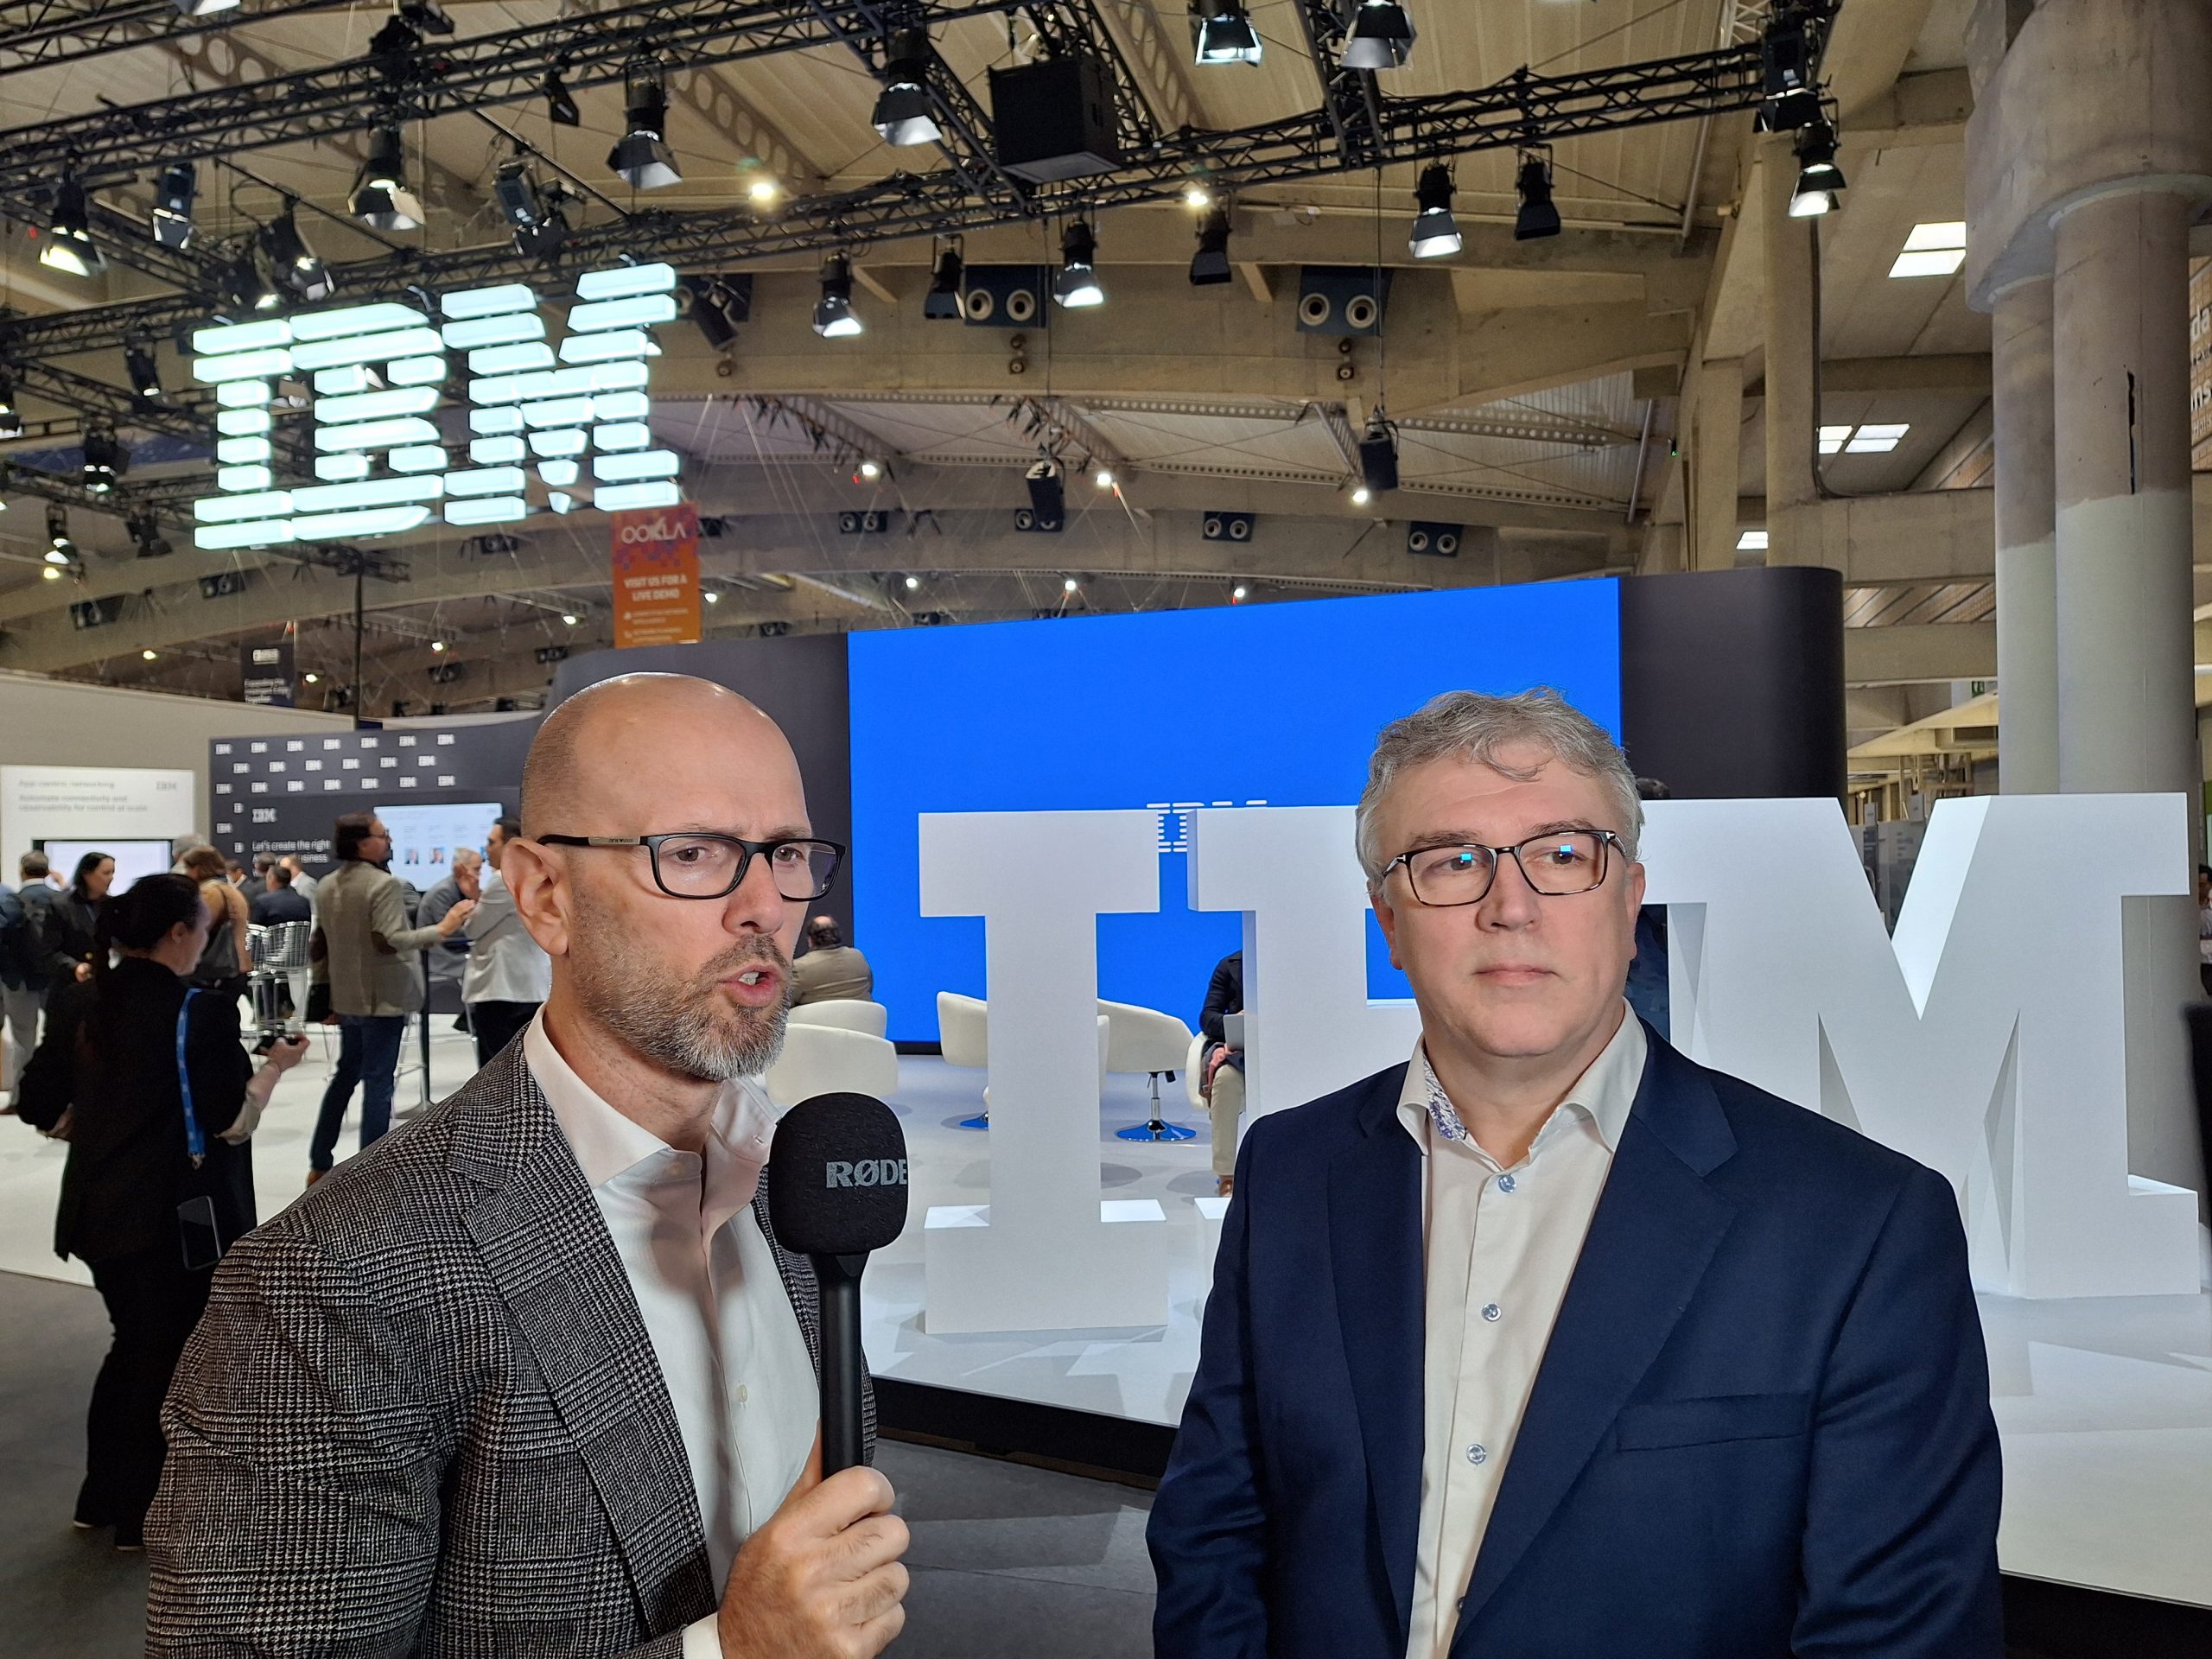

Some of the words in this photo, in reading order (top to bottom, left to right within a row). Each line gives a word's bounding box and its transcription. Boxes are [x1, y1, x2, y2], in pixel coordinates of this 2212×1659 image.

[193, 262, 679, 550] IBM
[620, 517, 687, 544] OOKLA
[624, 576, 646, 588] VISIT
[648, 575, 660, 588] US
[661, 574, 679, 586] FOR
[680, 573, 688, 584] A
[632, 590, 651, 601] LIVE
[652, 588, 680, 600] DEMO
[216, 744, 232, 754] IBM
[251, 742, 267, 753] IBM
[287, 741, 304, 752] IBM
[324, 739, 341, 750] IBM
[361, 738, 378, 748] IBM
[399, 735, 416, 747] IBM
[438, 734, 454, 745] IBM
[233, 763, 250, 773] IBM
[270, 761, 286, 772] IBM
[306, 760, 322, 771] IBM
[343, 759, 360, 769] IBM
[380, 757, 397, 767] IBM
[418, 755, 435, 766] IBM
[216, 783, 232, 794] IBM
[251, 782, 268, 792] IBM
[288, 780, 304, 791] IBM
[324, 779, 341, 790] IBM
[362, 779, 378, 789] IBM
[400, 777, 416, 787] IBM
[438, 775, 454, 786] IBM
[252, 808, 276, 823] IBM
[217, 823, 232, 834] IBM
[252, 840, 270, 852] Let's
[271, 841, 296, 851] create
[297, 839, 311, 851] the
[311, 839, 331, 853] right
[297, 852, 328, 863] usiness
[825, 1159, 907, 1188] RØDE
